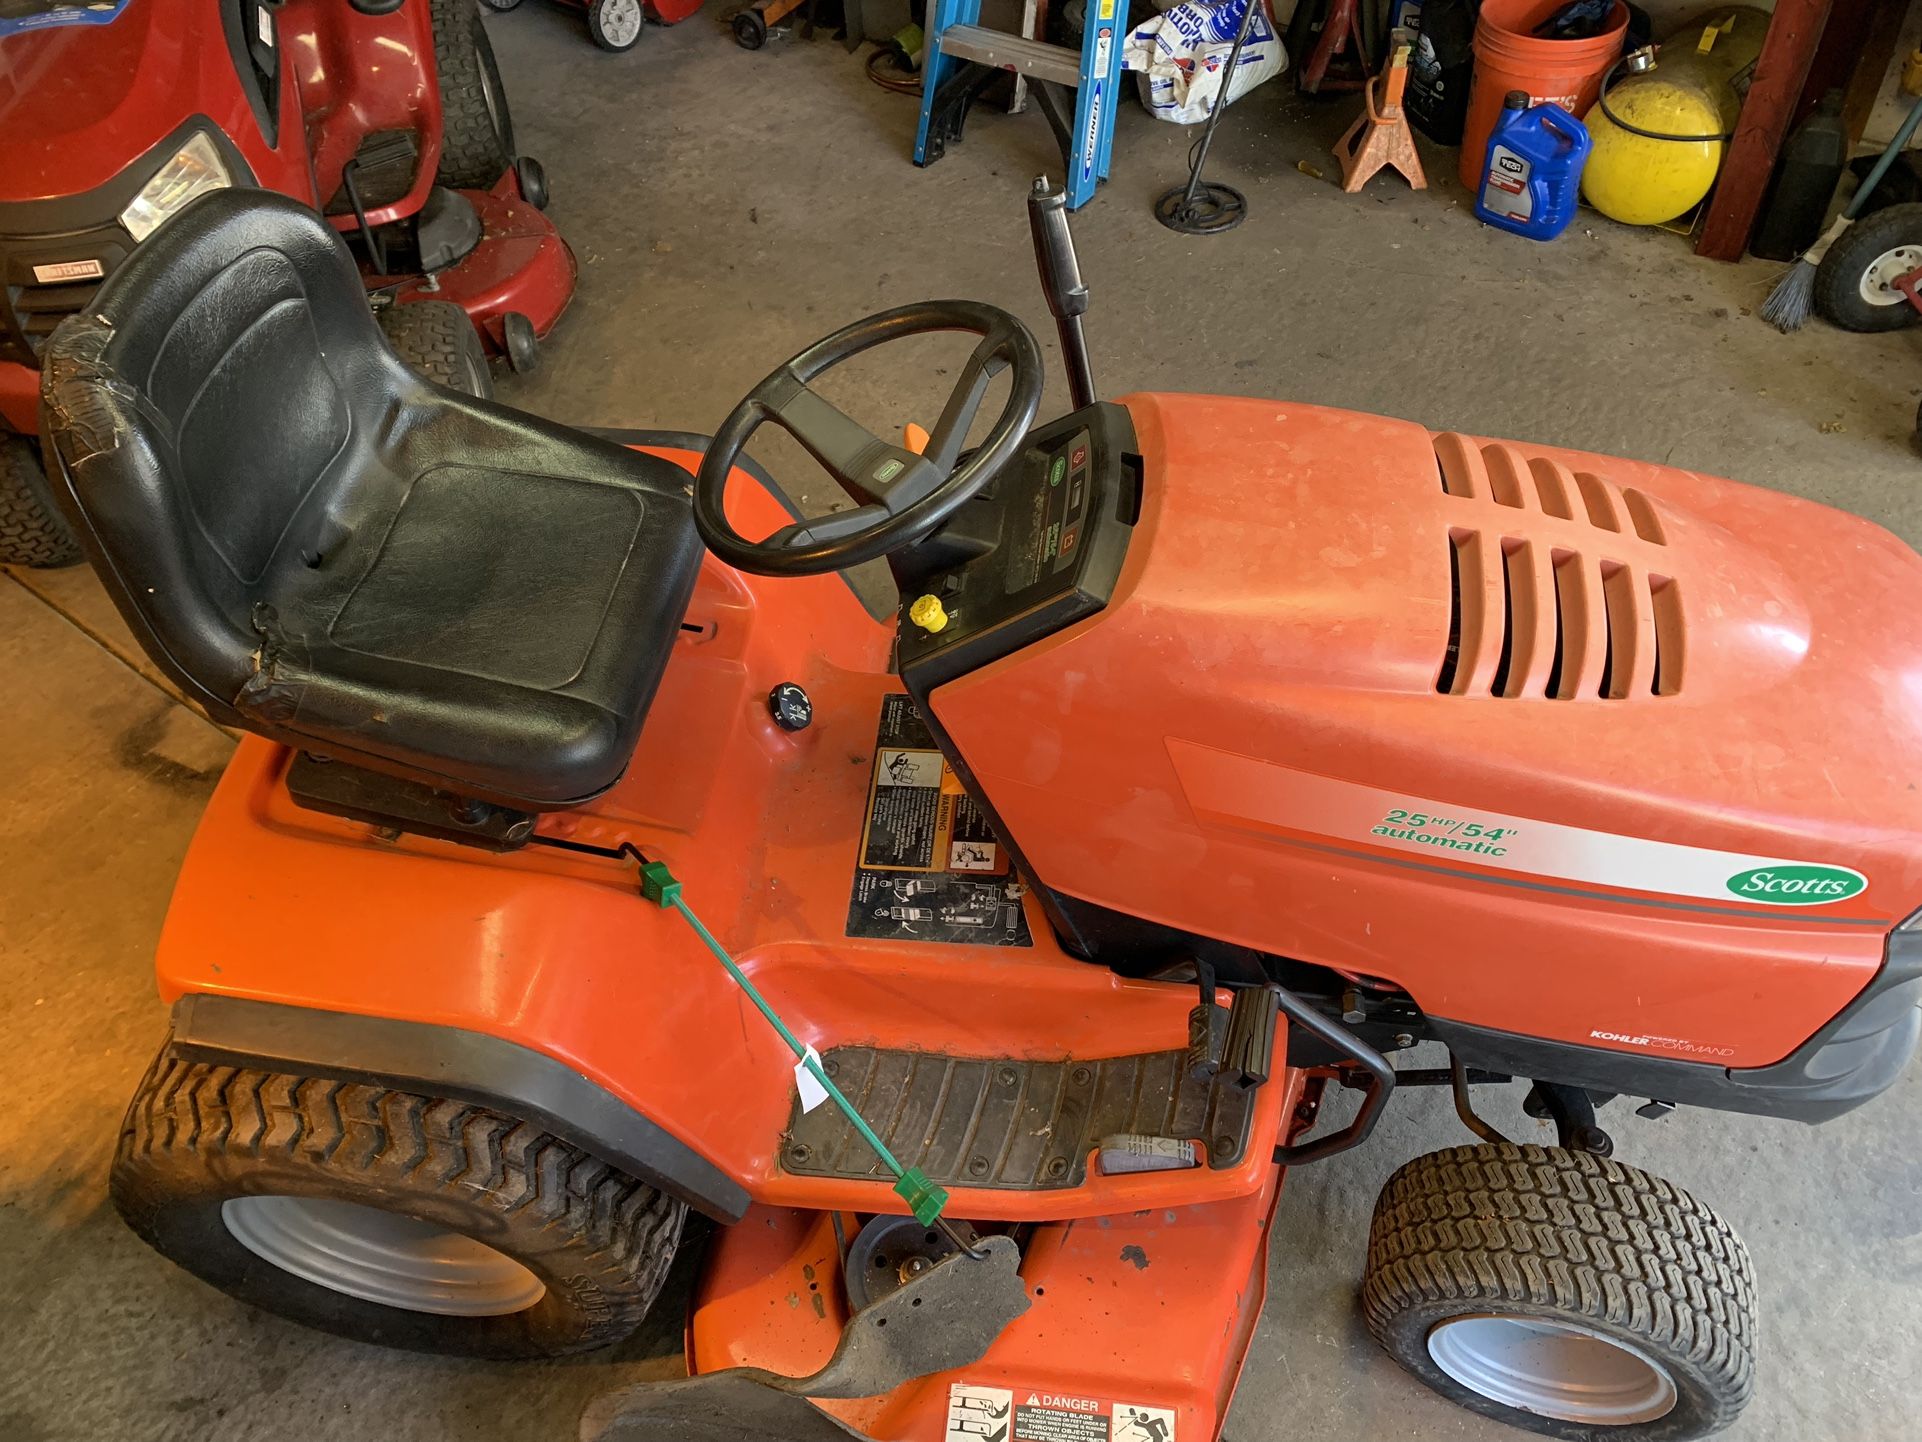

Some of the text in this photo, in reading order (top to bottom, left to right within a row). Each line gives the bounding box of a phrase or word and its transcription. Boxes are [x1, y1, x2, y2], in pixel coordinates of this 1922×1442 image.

[1086, 101, 1099, 161] WERNER
[938, 795, 950, 831] WARNING
[1371, 824, 1507, 857] automatic
[1740, 872, 1849, 895] Scotts
[1590, 1030, 1735, 1057] KOHLER COMMAND
[1031, 1408, 1067, 1417] ROTATING
[1043, 1395, 1099, 1412] DANGER
[1028, 1424, 1094, 1436] THROWN OBJECTS
